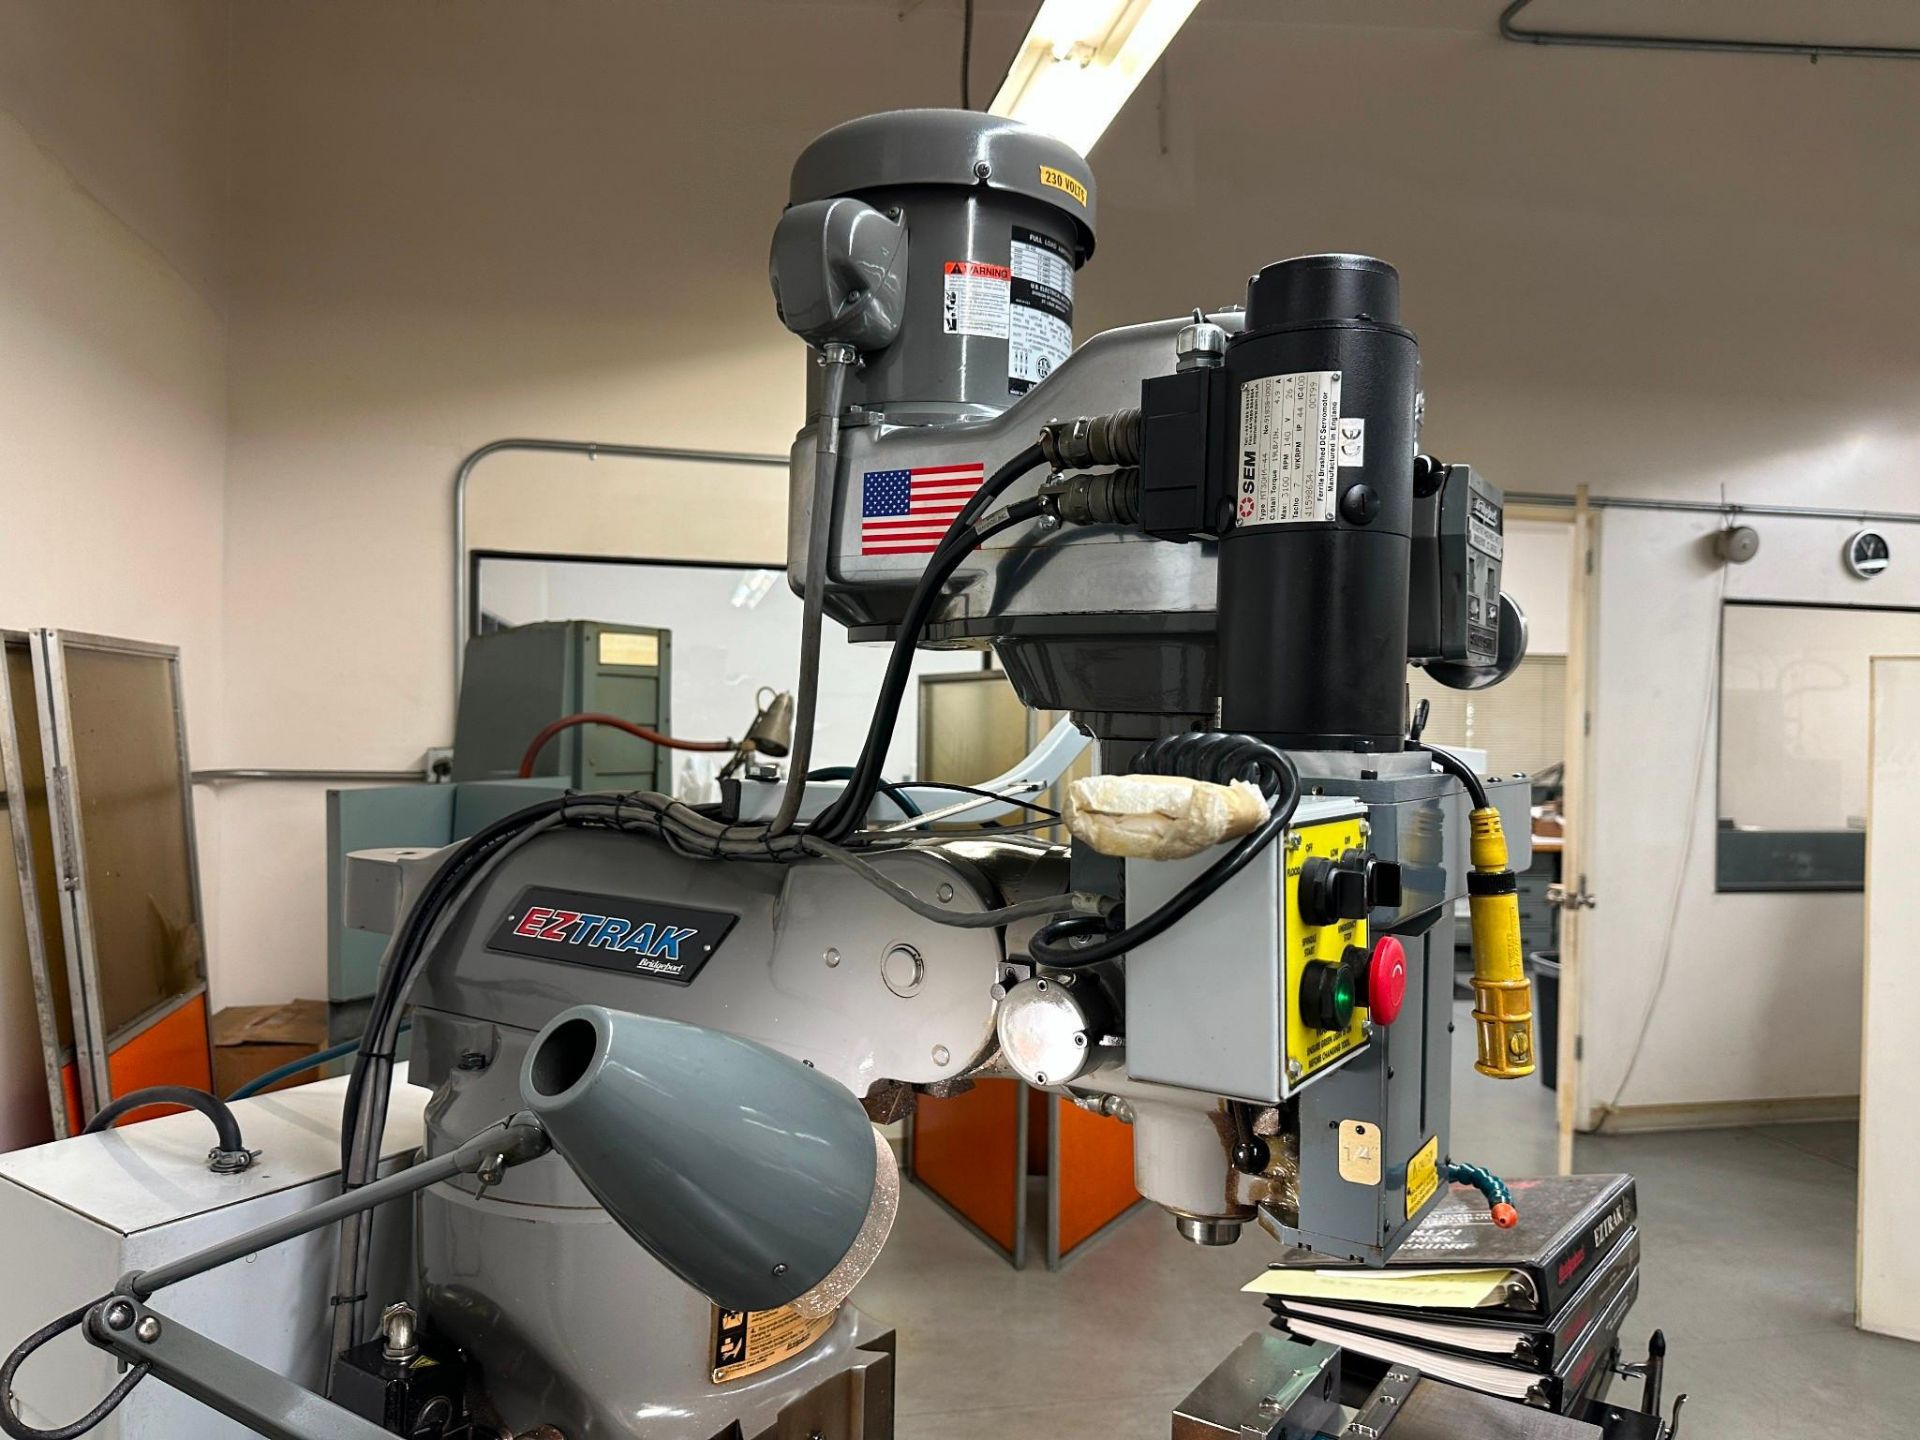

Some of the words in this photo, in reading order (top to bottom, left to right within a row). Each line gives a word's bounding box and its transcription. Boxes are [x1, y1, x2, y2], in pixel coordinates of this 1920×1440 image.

[1045, 170, 1063, 186] 230
[1064, 178, 1085, 203] VOLTS
[1286, 388, 1293, 399] 26
[1297, 407, 1303, 418] 44
[1319, 392, 1328, 434] Servomotor
[1329, 401, 1337, 431] England
[1319, 435, 1326, 445] DC
[1243, 451, 1256, 494] SEM
[1328, 443, 1336, 492] Manufactured
[1271, 470, 1279, 494] Torque
[1305, 842, 1313, 852] OFF
[514, 906, 698, 960] EZTRAK
[1343, 932, 1352, 942] STOP
[1304, 945, 1316, 957] START
[637, 957, 684, 974] Bridgeport
[1593, 1203, 1624, 1248] EZTRAK
